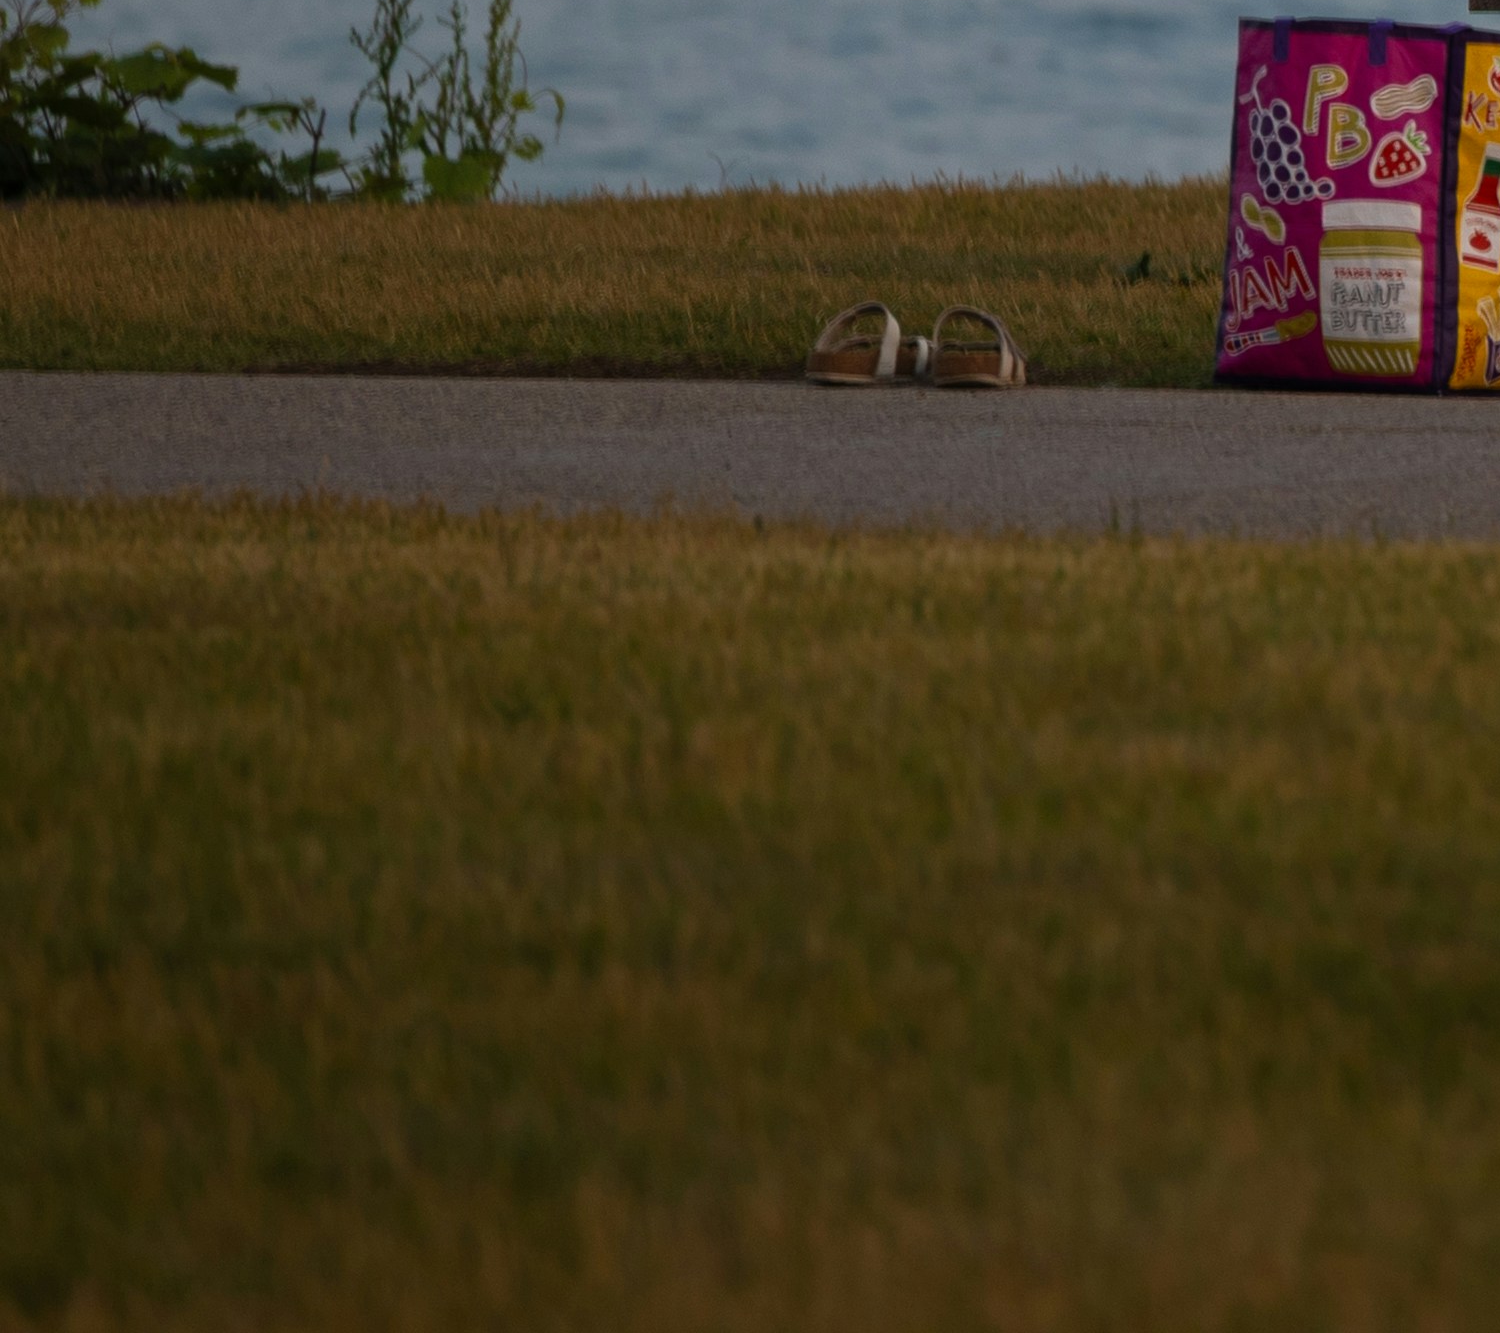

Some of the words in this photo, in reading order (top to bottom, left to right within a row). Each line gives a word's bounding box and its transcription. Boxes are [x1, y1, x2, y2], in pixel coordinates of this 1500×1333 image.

[1235, 226, 1254, 262] &
[1226, 245, 1317, 332] JAM
[1330, 279, 1405, 309] PEANUT
[1329, 309, 1406, 335] BUTTER
